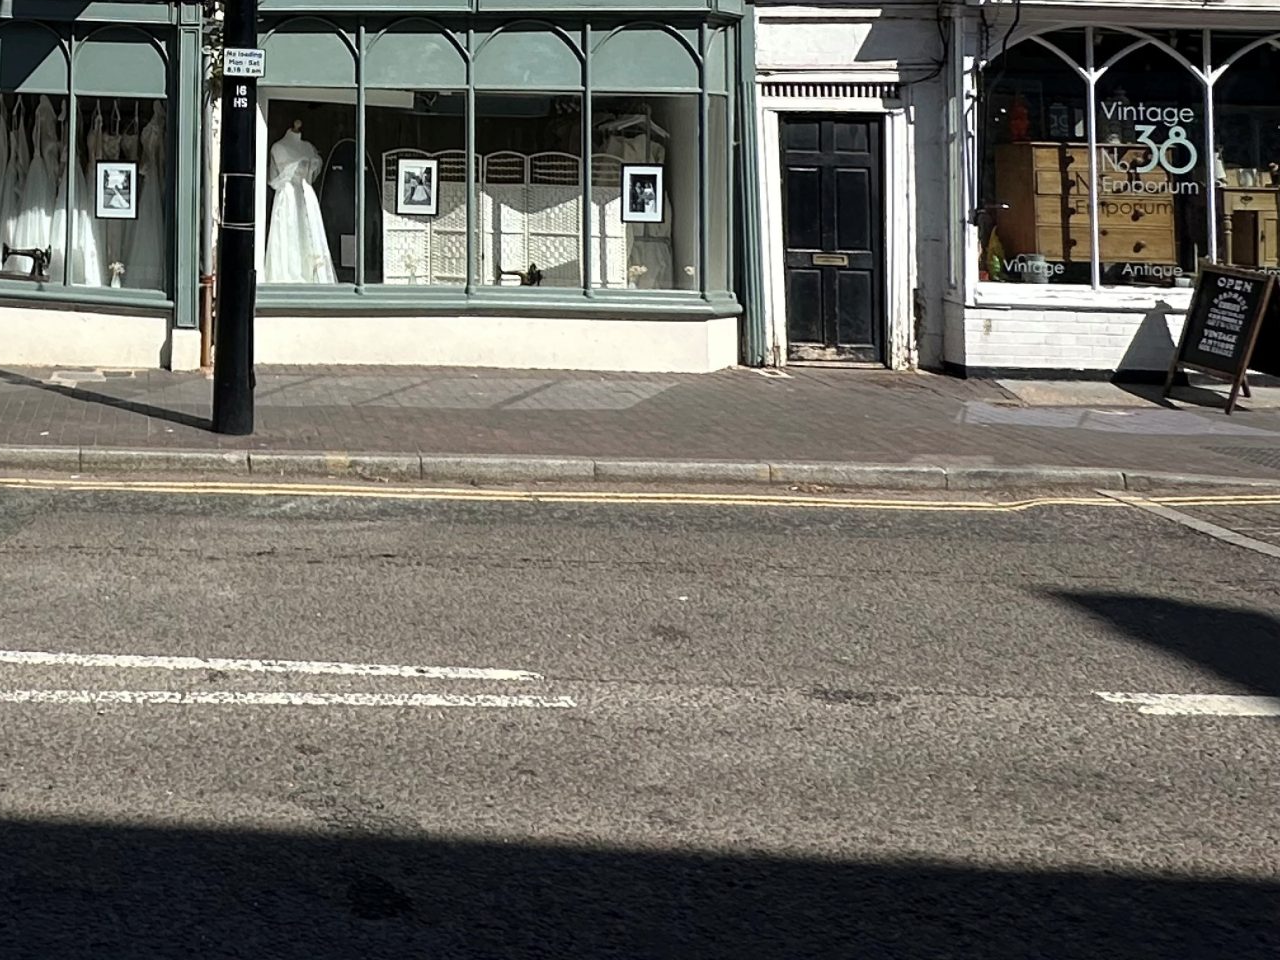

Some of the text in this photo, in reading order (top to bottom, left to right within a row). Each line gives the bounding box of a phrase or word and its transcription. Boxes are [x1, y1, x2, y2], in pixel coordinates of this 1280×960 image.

[233, 97, 248, 108] HS
[1100, 101, 1195, 126] Vintage
[1134, 124, 1198, 175] 38
[1102, 176, 1199, 195] Emporium
[1003, 258, 1065, 277] Vintage
[1122, 262, 1184, 279] Antique
[1217, 276, 1254, 293] OPEN
[1203, 328, 1238, 343] VINTAGE
